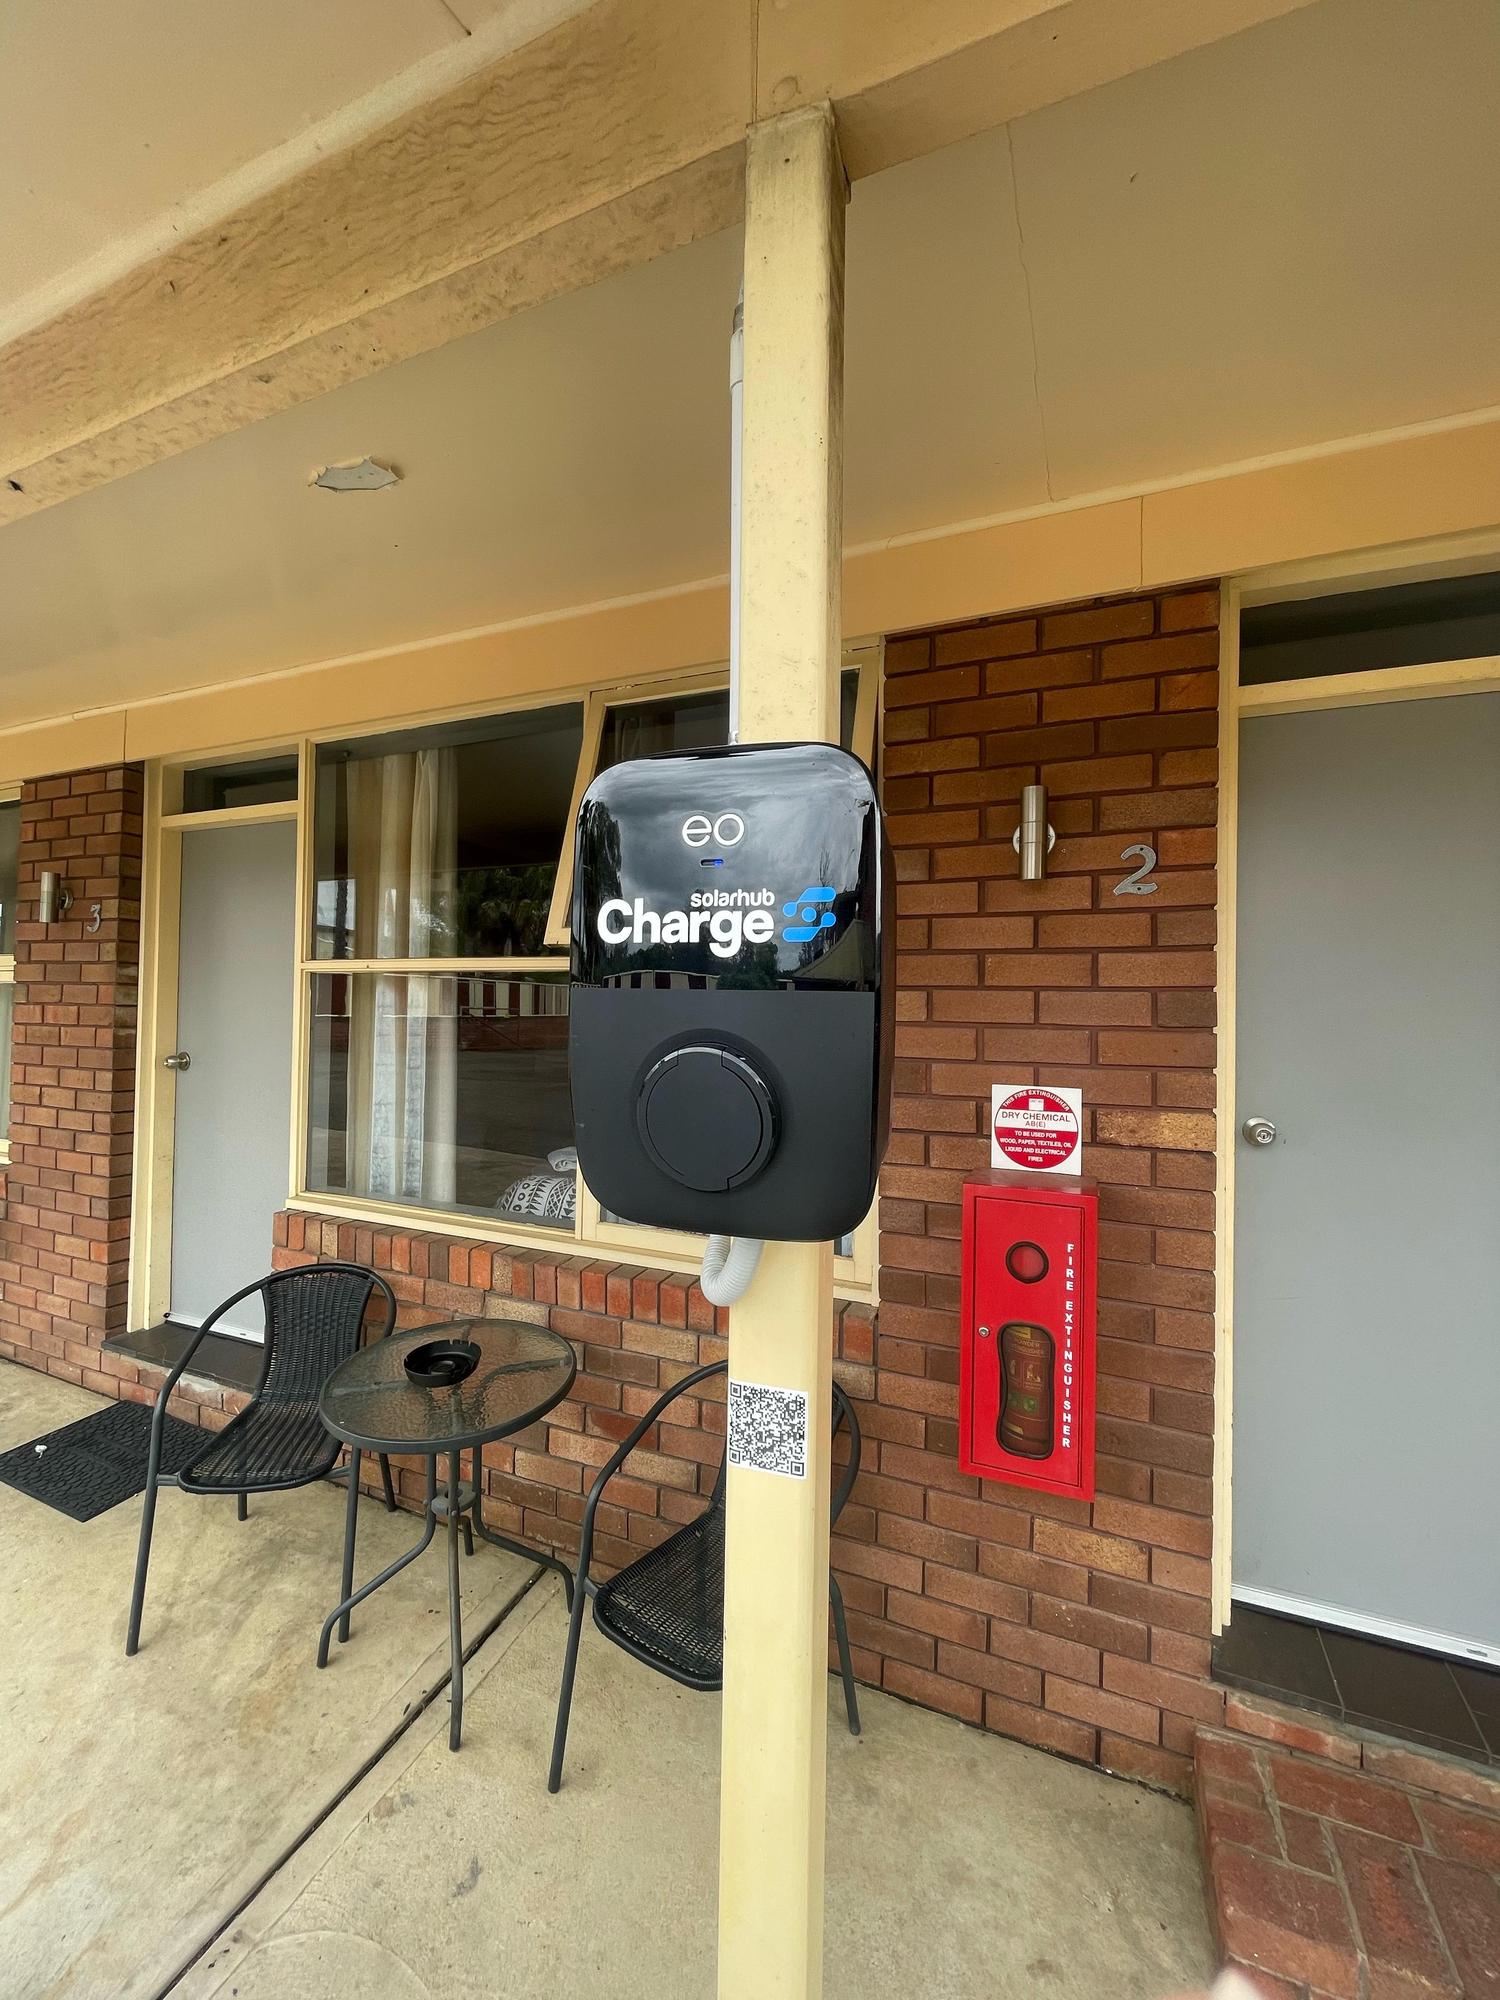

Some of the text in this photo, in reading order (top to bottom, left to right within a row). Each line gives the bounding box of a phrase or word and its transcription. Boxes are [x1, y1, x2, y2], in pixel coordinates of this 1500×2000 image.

[1113, 844, 1158, 896] 2
[690, 888, 775, 907] solarhub
[86, 904, 101, 933] 3
[597, 898, 775, 958] Charge
[1003, 1090, 1070, 1112] THIS FIRE EXTINGUISHER
[1002, 1111, 1070, 1122] DRY CHEMICAL
[1035, 1148, 1067, 1156] ELECTRICAL
[1062, 1243, 1075, 1448] FIRE EXTINGUISHER
